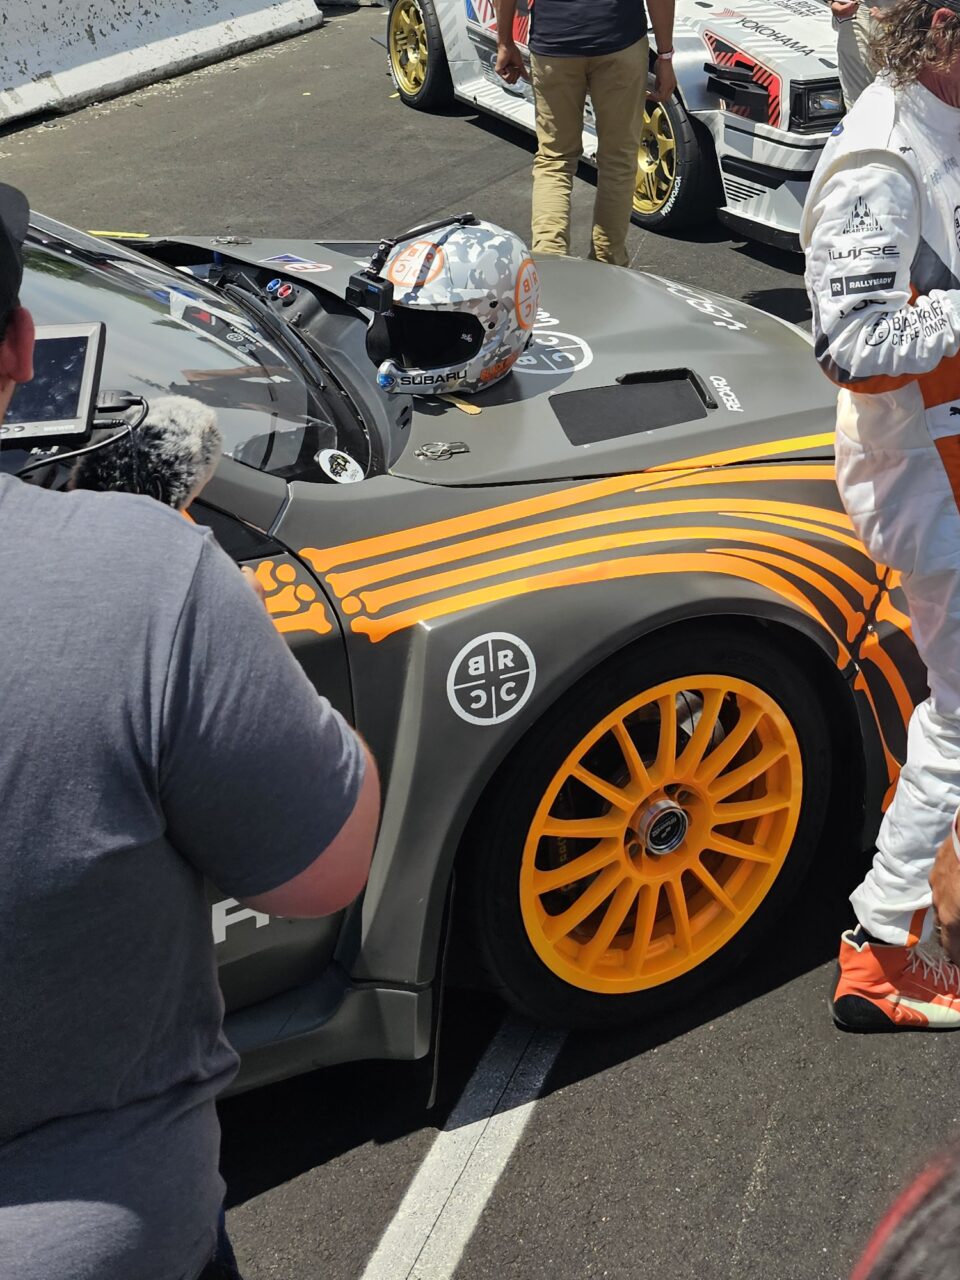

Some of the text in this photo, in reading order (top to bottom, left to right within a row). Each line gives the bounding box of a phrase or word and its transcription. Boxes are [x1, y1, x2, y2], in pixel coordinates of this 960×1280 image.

[736, 17, 815, 56] YOKOHAMA
[400, 371, 467, 386] SUBARU
[709, 375, 745, 413] RECARO
